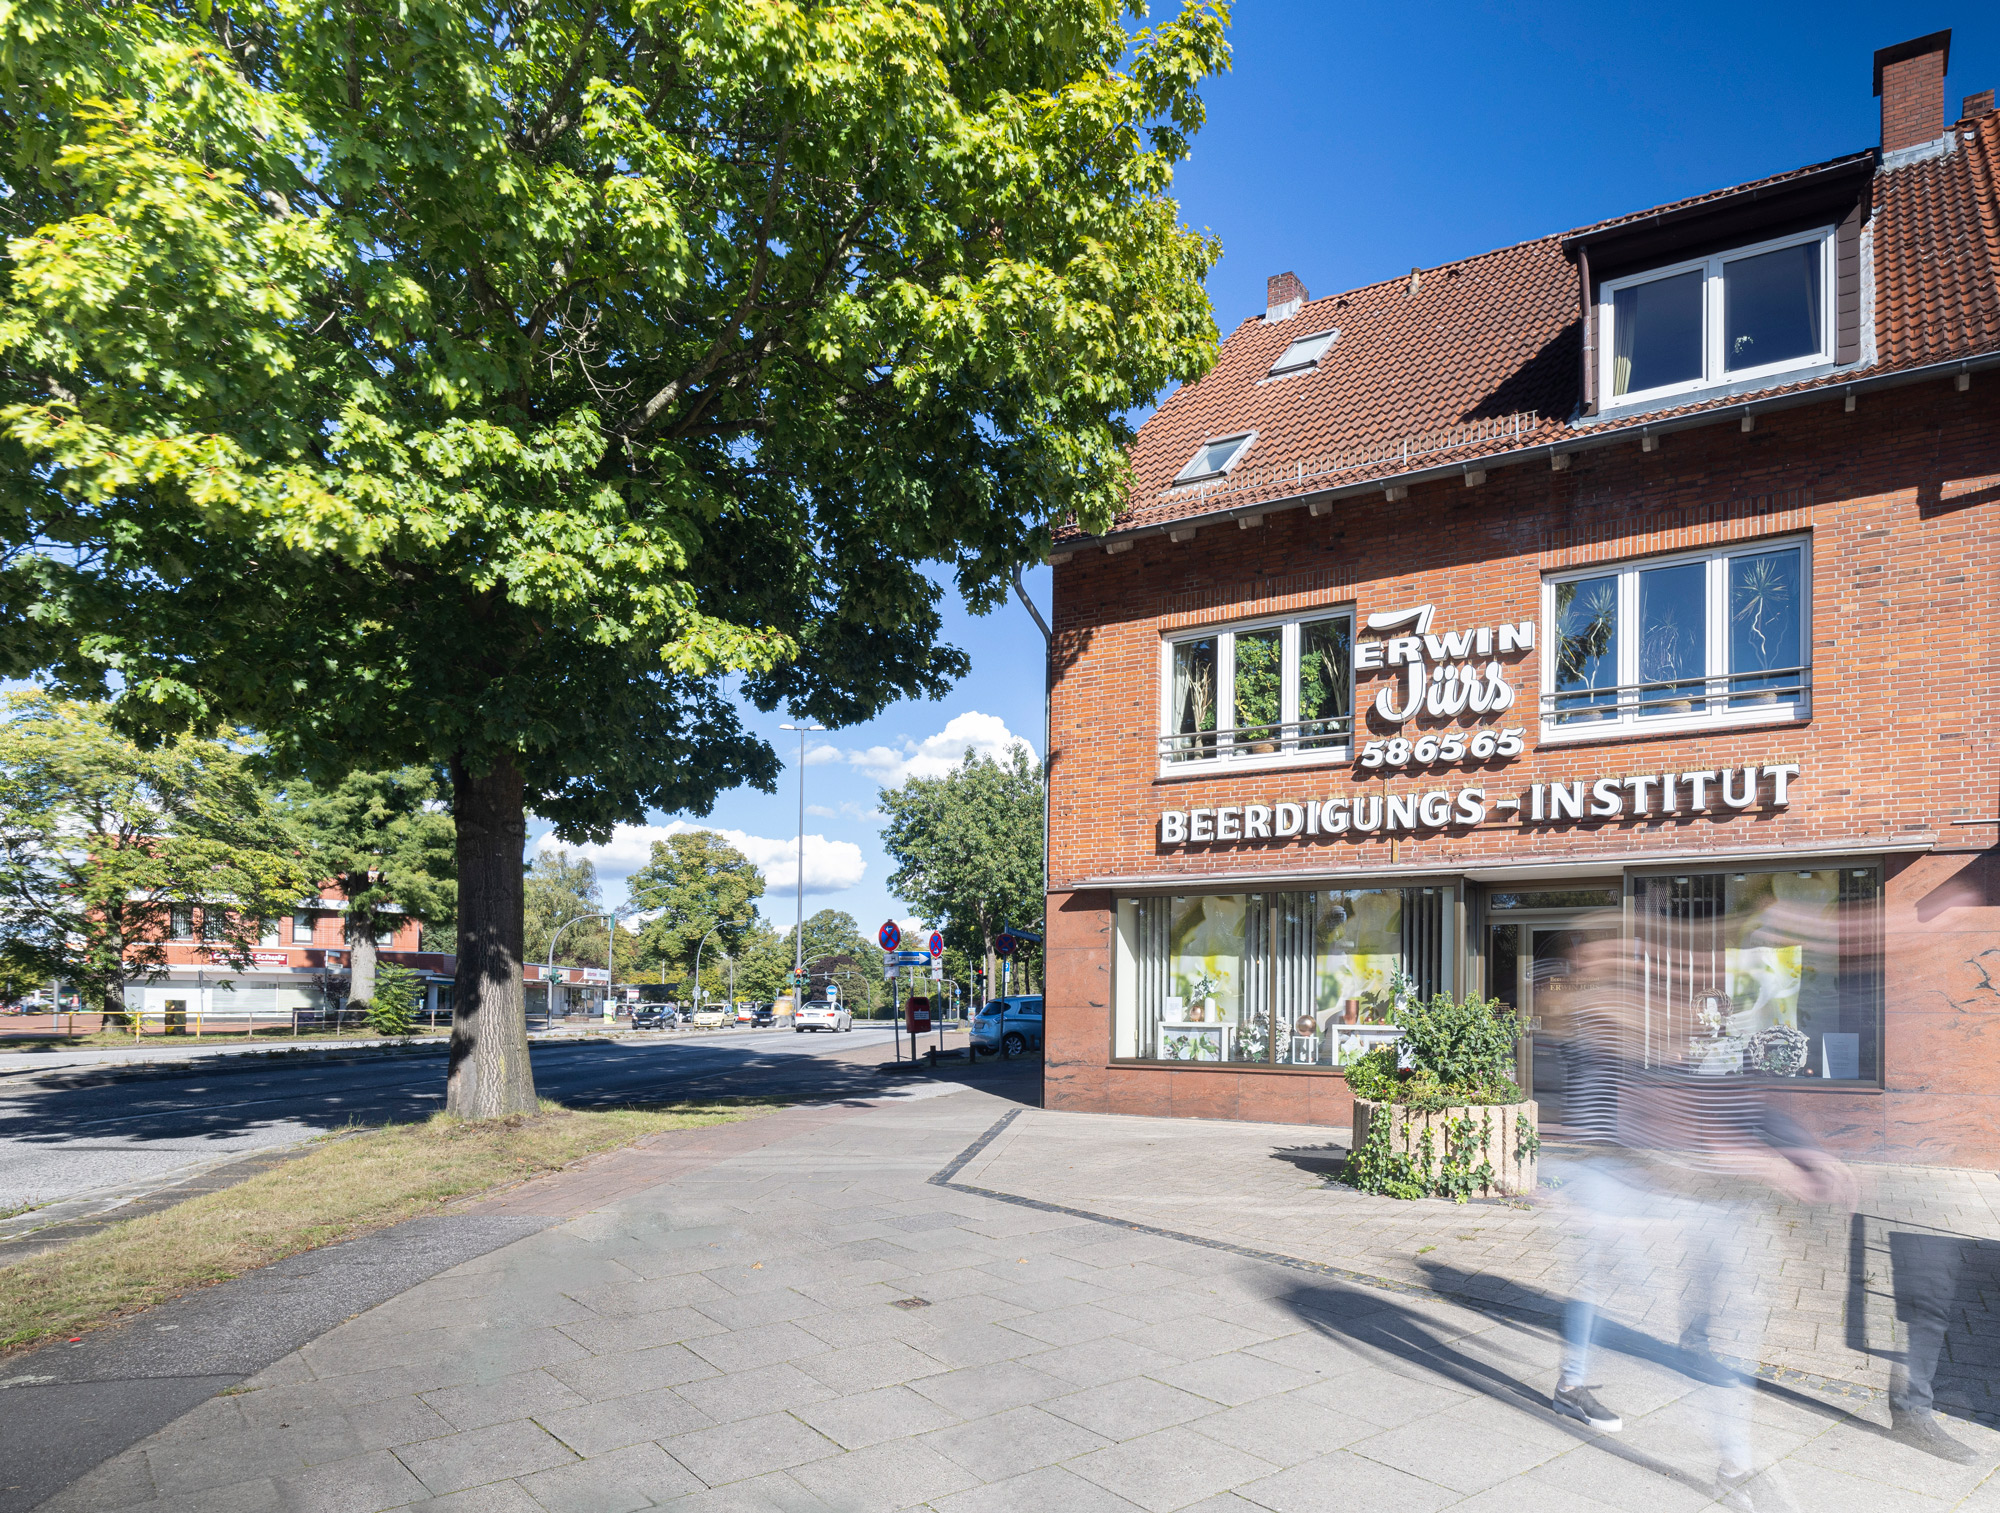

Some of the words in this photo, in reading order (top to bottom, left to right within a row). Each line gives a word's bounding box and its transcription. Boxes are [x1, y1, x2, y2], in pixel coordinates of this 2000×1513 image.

[1354, 620, 1535, 671] ERWIN
[1367, 604, 1515, 723] Jürs
[1161, 788, 1486, 844] BEERDIGUNGS
[1530, 763, 1800, 822] INSTITUT
